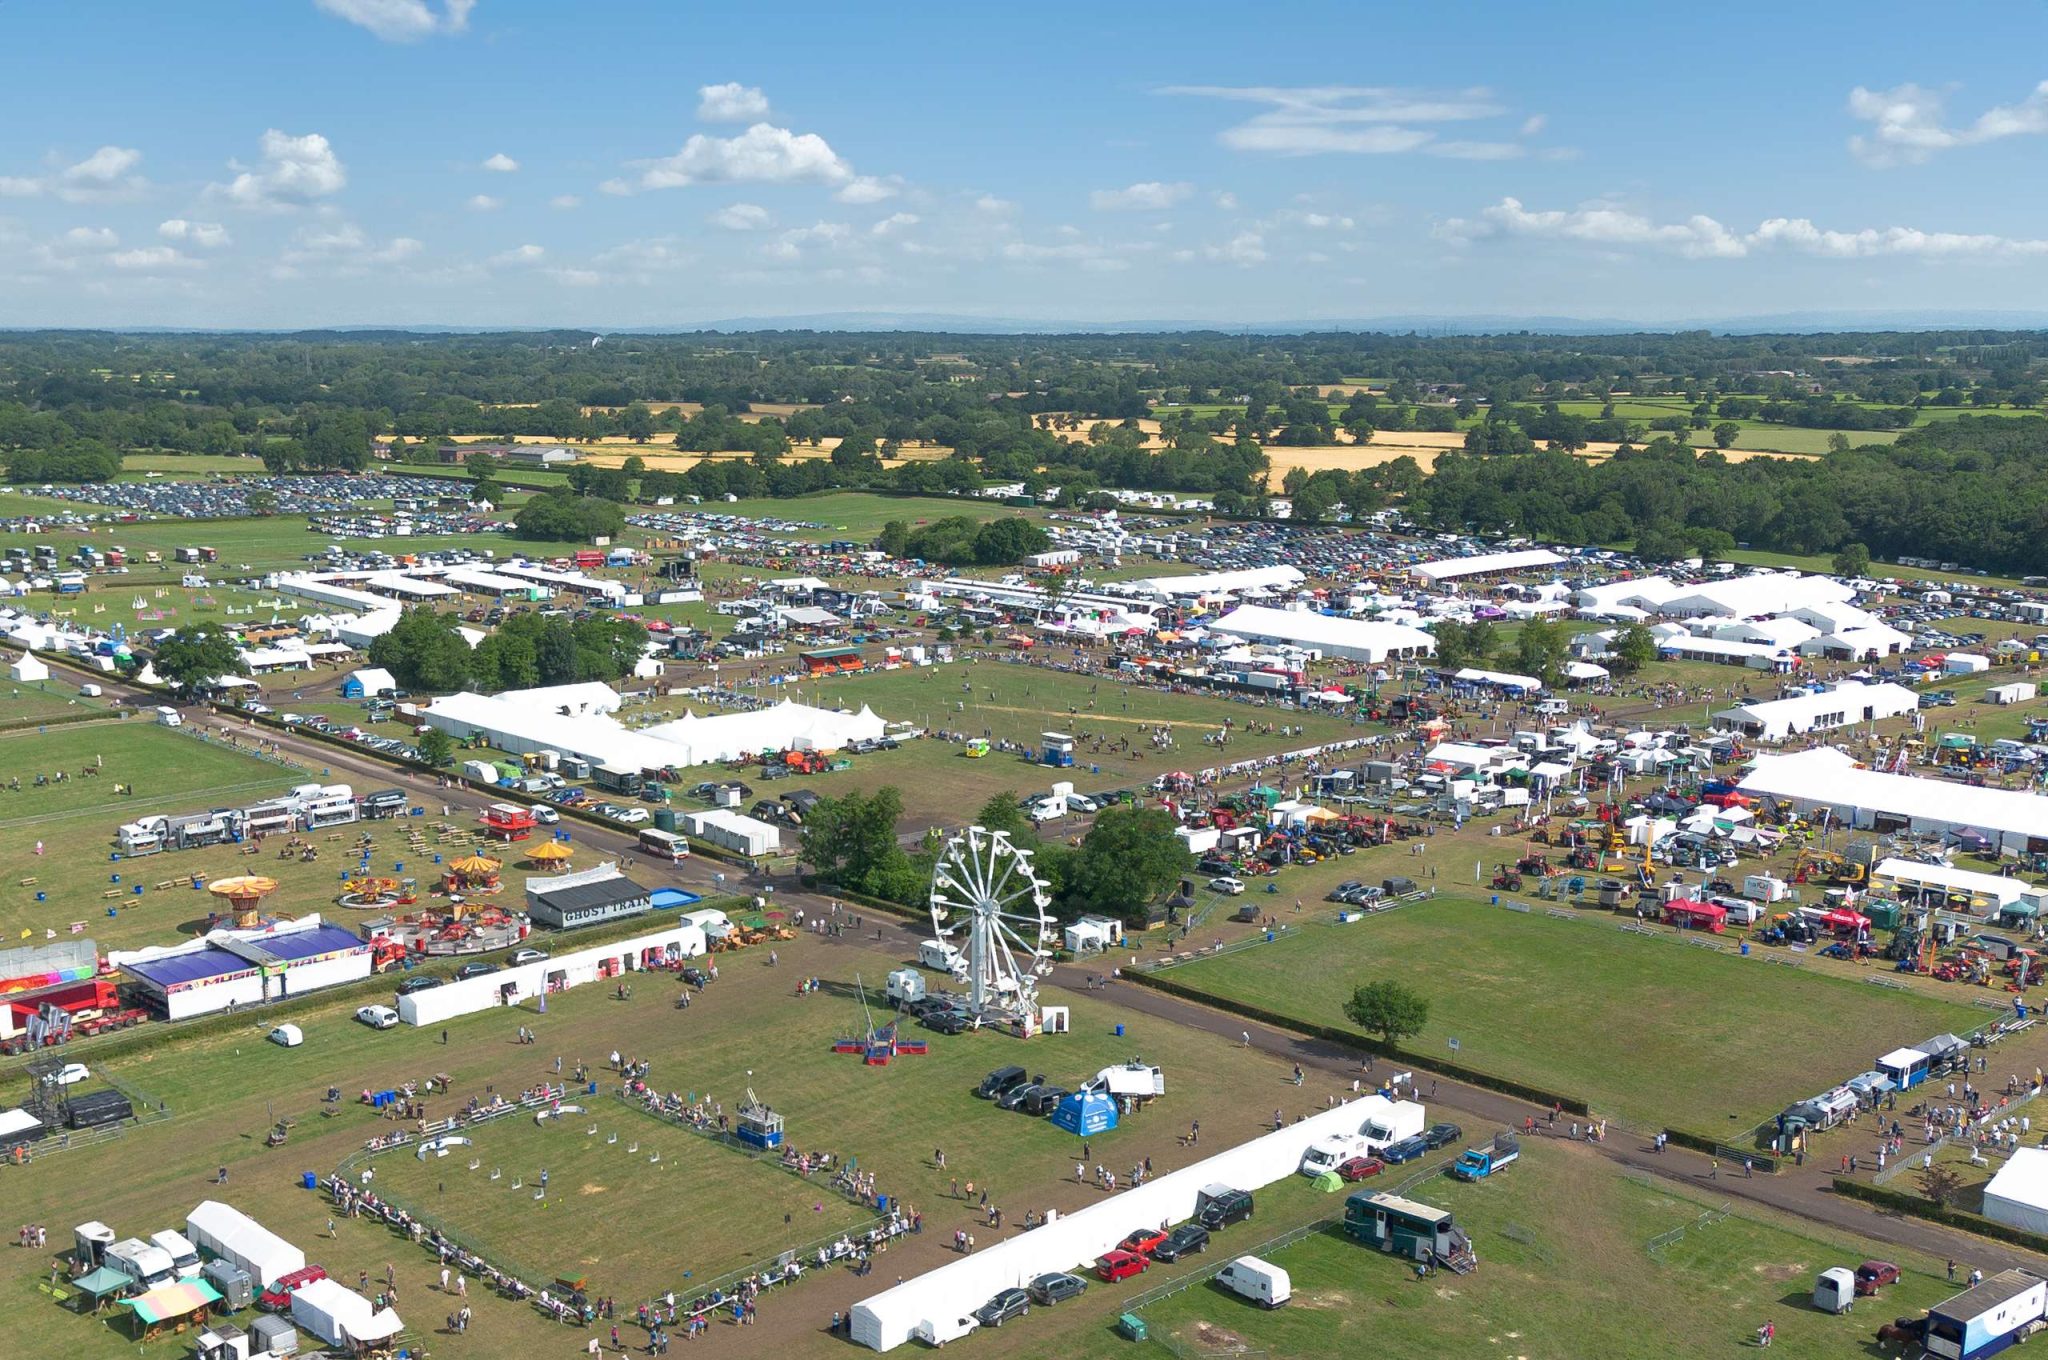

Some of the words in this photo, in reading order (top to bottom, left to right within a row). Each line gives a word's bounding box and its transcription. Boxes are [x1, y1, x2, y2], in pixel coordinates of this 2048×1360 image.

[565, 906, 606, 921] GHOST
[613, 897, 650, 911] TRAIN
[203, 970, 259, 986] MUSIC
[287, 954, 335, 968] HALL
